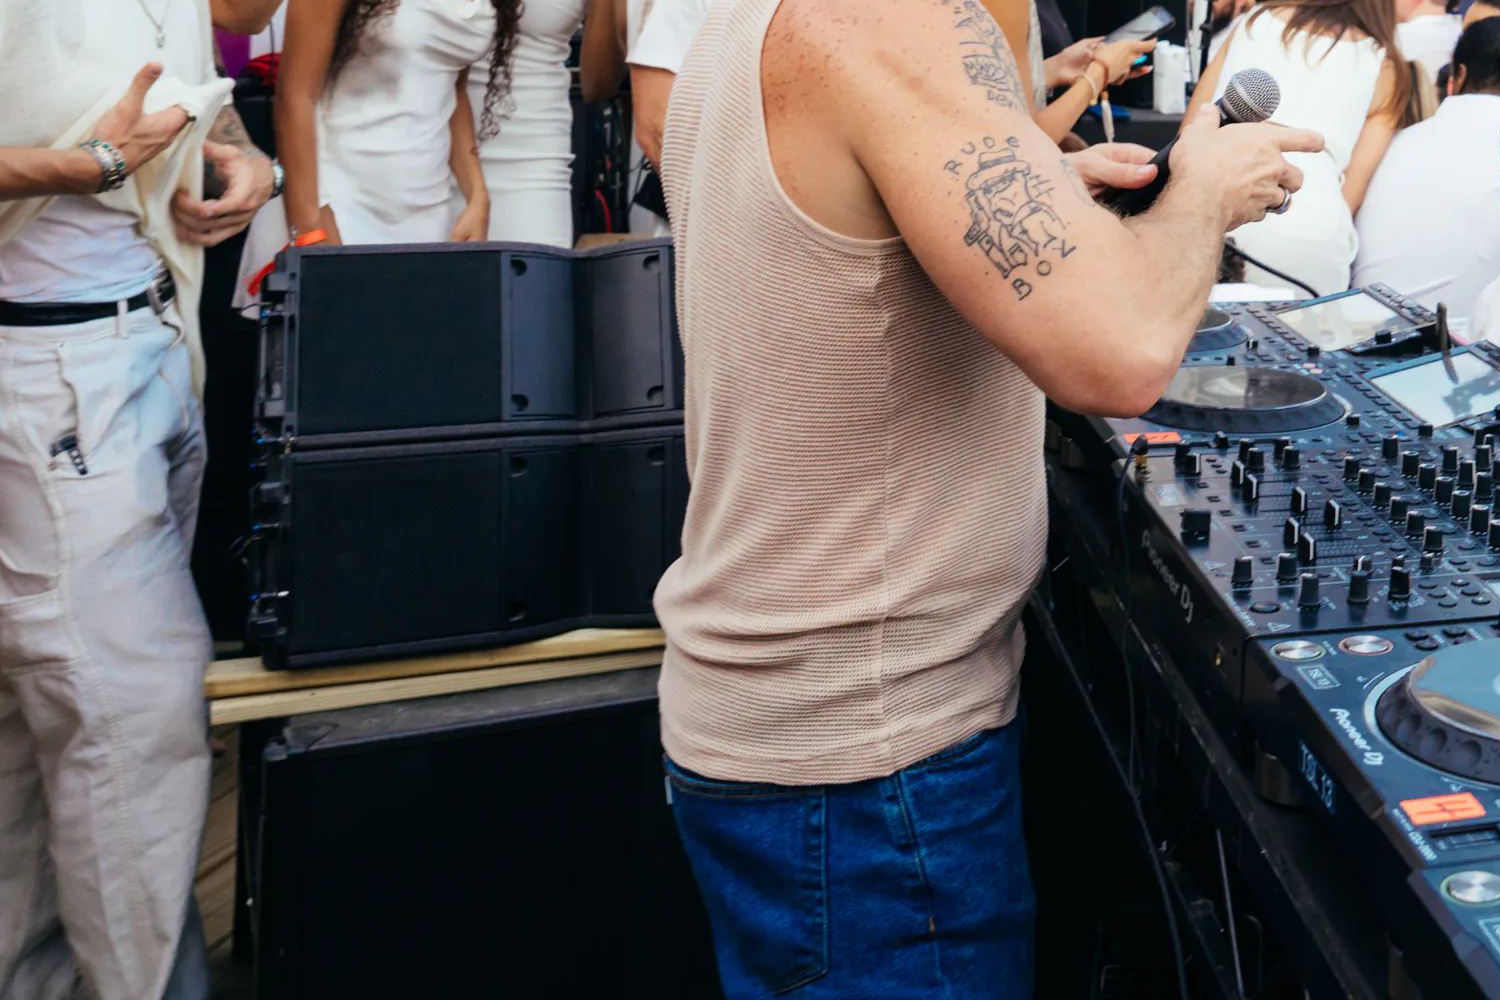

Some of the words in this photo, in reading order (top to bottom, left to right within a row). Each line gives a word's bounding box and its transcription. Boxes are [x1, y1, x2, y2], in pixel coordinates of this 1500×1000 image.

[1011, 238, 1077, 301] BOY
[1329, 708, 1372, 751] Pioneer
[1363, 752, 1384, 766] DJ
